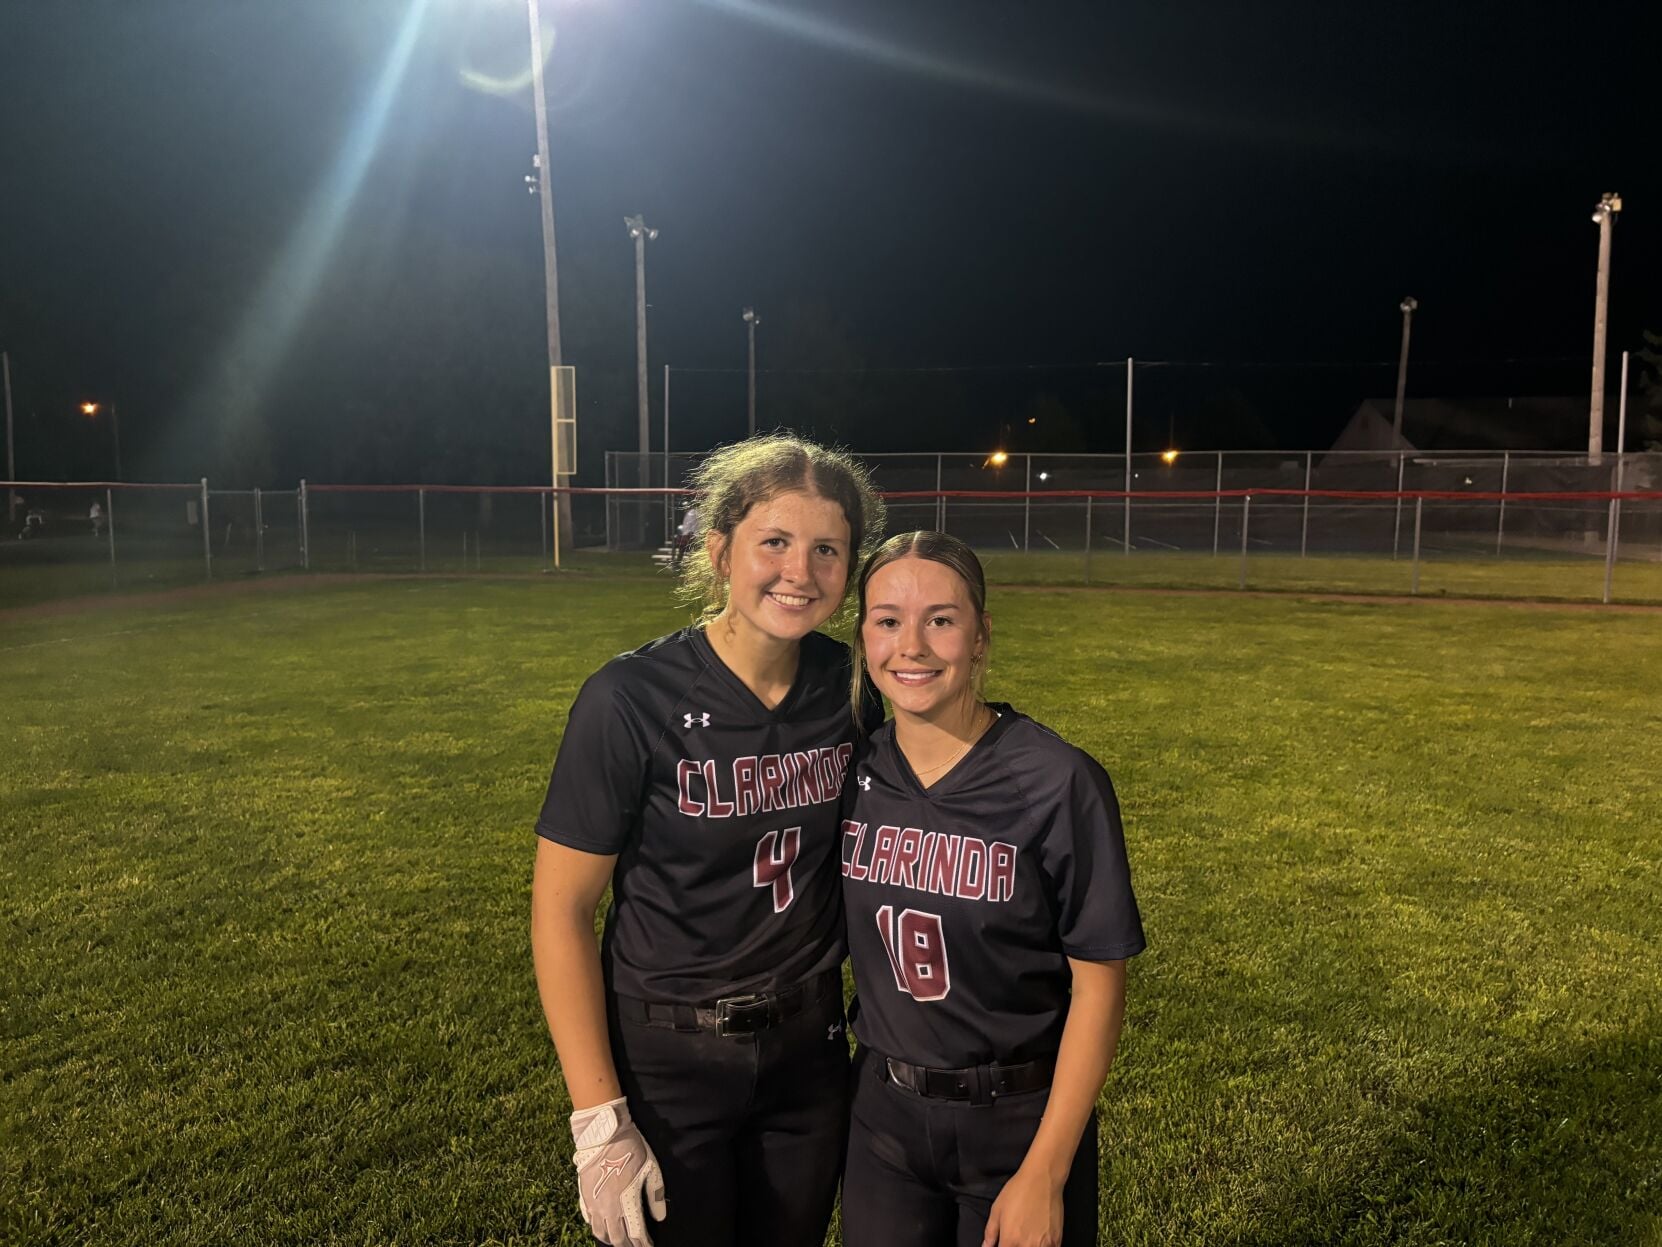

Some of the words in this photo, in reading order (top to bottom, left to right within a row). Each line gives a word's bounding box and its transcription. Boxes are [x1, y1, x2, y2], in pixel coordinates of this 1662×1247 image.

[753, 826, 801, 913] 4
[841, 819, 1018, 902] CLARINDA
[875, 905, 951, 1001] 18
